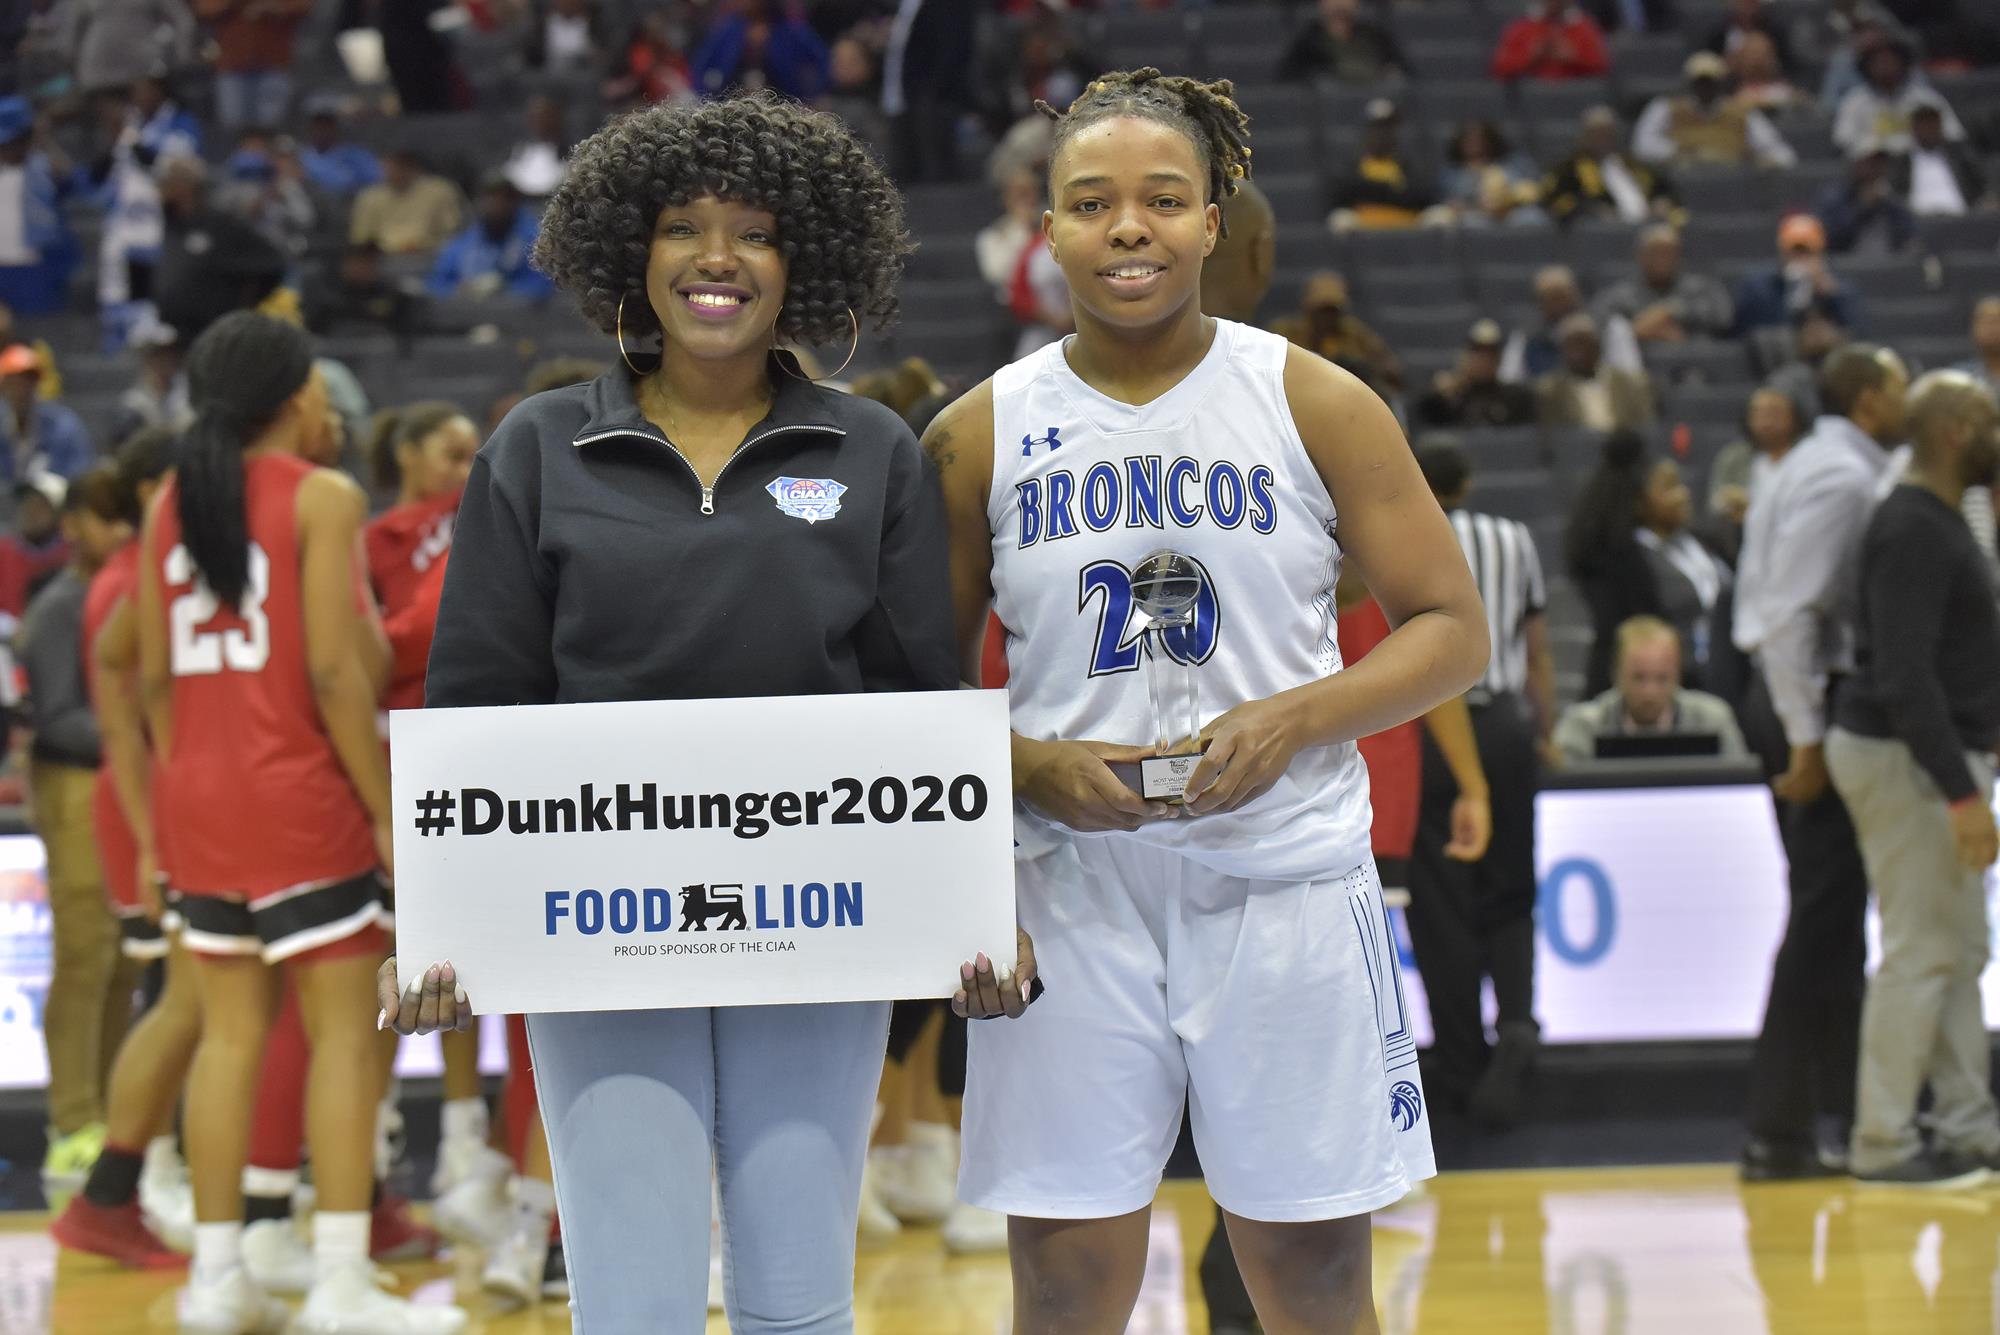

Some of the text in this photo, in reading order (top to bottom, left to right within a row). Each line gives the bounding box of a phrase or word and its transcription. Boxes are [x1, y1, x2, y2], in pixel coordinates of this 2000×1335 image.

[790, 489, 827, 499] CIAA
[1015, 455, 1278, 550] BRONCOS
[415, 774, 989, 839] #DunkHunger2020
[545, 881, 864, 936] FOOD LION
[614, 940, 796, 957] PROUD SPONSOR OF THE CIAA
